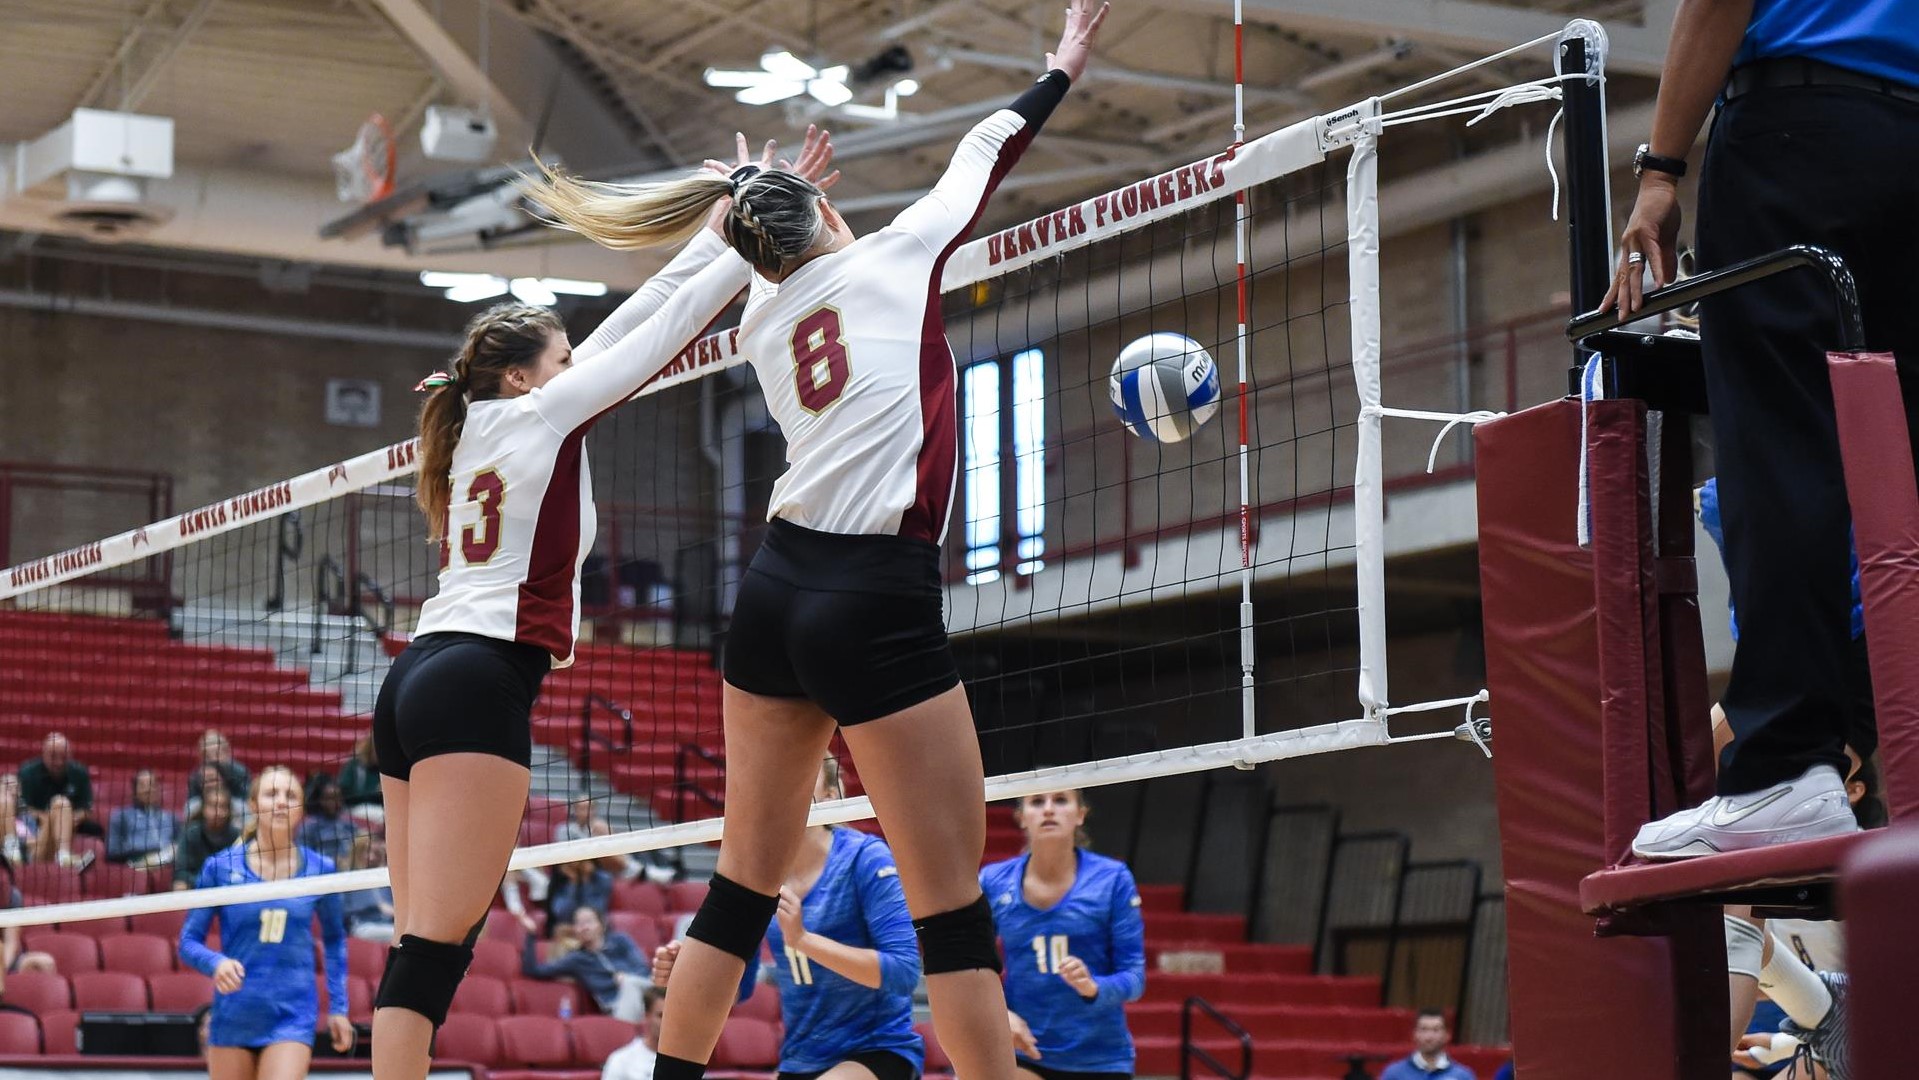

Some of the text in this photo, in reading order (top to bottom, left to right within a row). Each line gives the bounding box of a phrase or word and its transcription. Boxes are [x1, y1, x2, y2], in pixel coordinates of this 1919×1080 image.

[987, 154, 1229, 266] DENVER PIONEERS
[788, 302, 853, 418] 8
[180, 481, 292, 537] DENVER PIONEERS
[11, 558, 50, 588] DENVER
